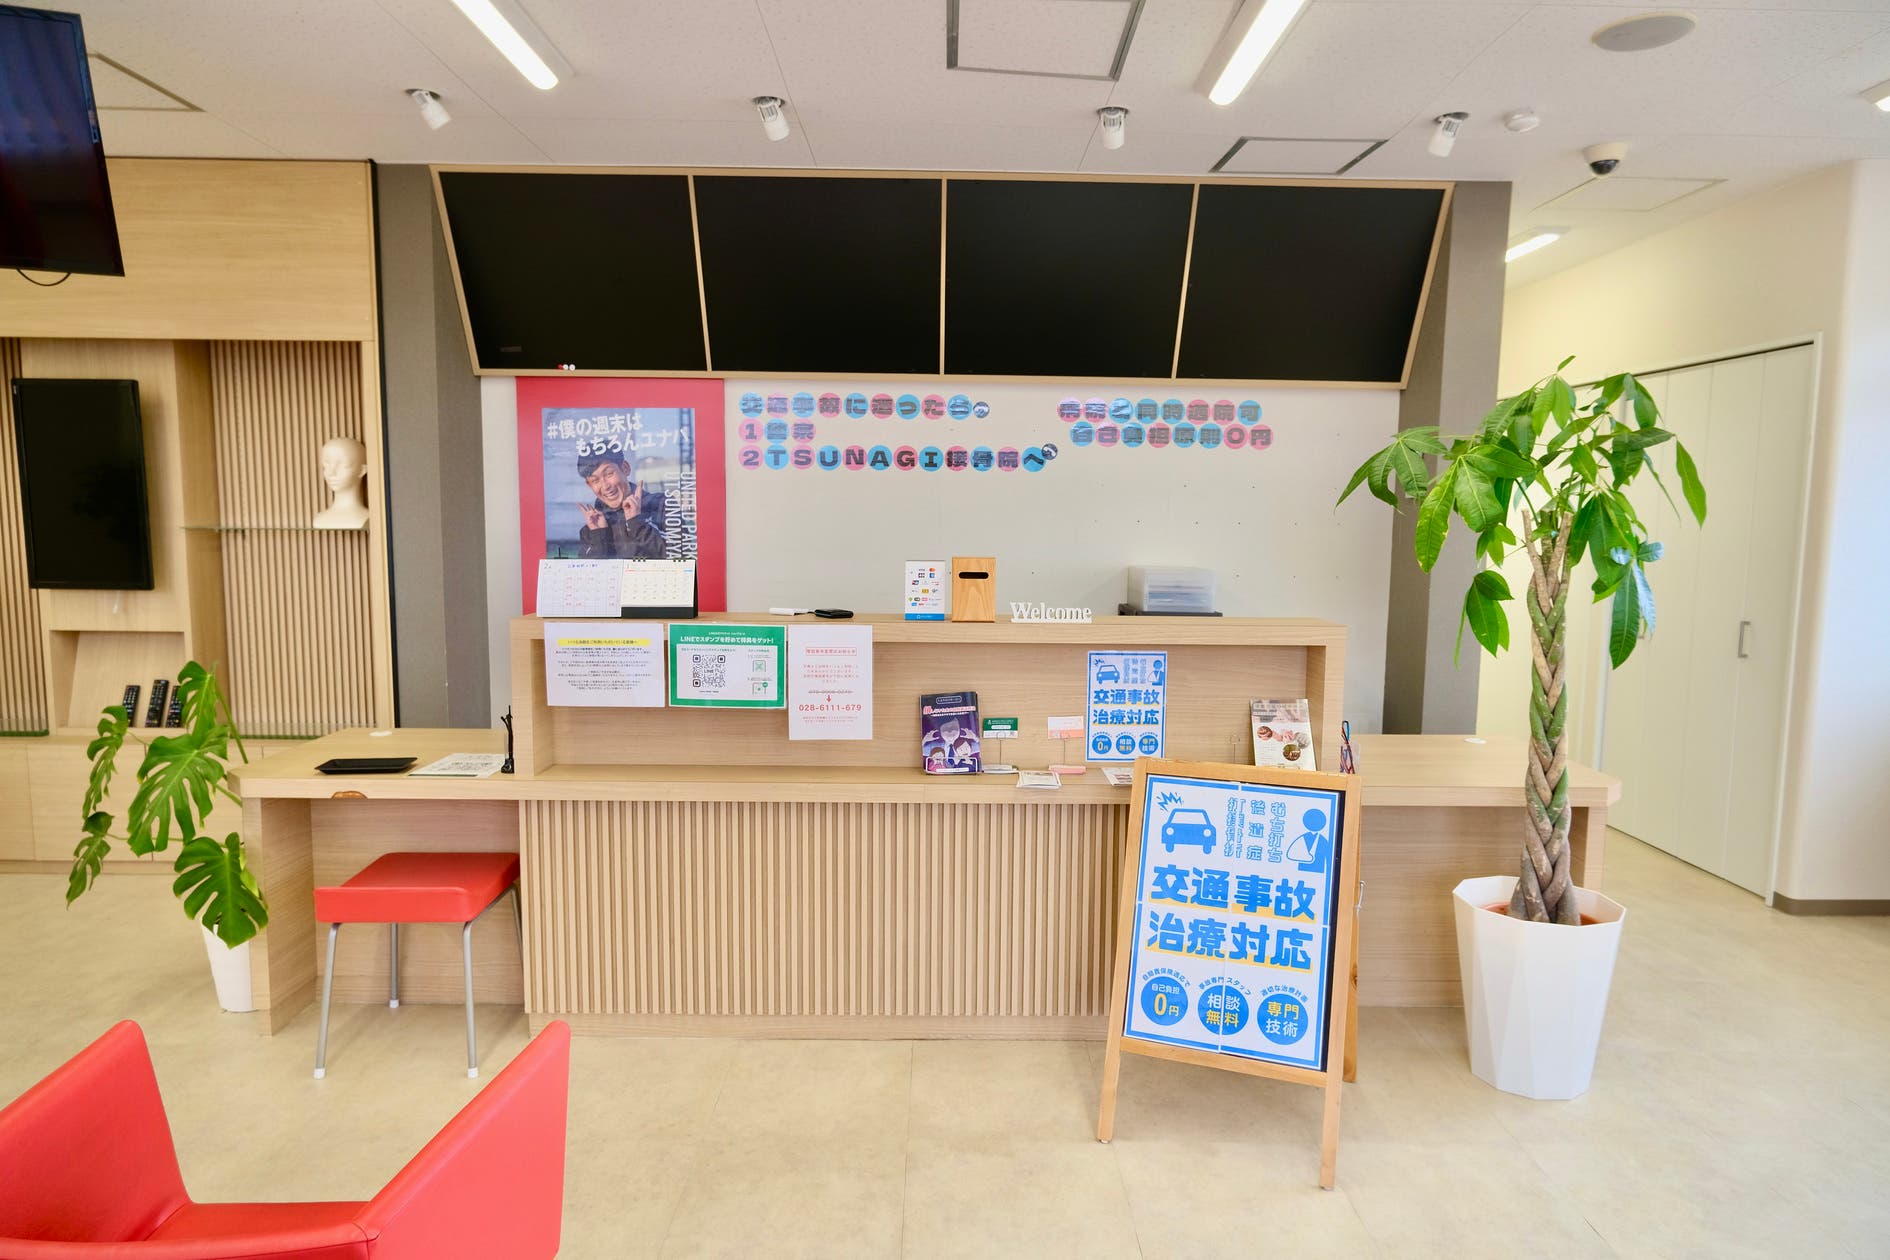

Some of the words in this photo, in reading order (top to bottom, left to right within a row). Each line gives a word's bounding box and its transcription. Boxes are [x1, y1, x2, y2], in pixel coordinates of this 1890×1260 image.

[547, 413, 643, 439] #僕の週末は
[680, 471, 697, 521] UNITED
[664, 471, 682, 560] UTSUNOMIYA
[1010, 602, 1092, 620] Welcome
[1093, 689, 1160, 705] 交通事故
[799, 704, 862, 712] 028-6111-679
[1093, 709, 1160, 725] 治療対応
[1267, 801, 1287, 863] むち打ち
[1150, 863, 1317, 921] 交通事故
[1147, 910, 1314, 970] 治療対応
[1154, 993, 1180, 1017] 0円
[1207, 992, 1241, 1012] 相談
[1266, 1001, 1299, 1020] 専門
[1205, 1010, 1240, 1028] 無料
[1265, 1019, 1299, 1038] 技術
